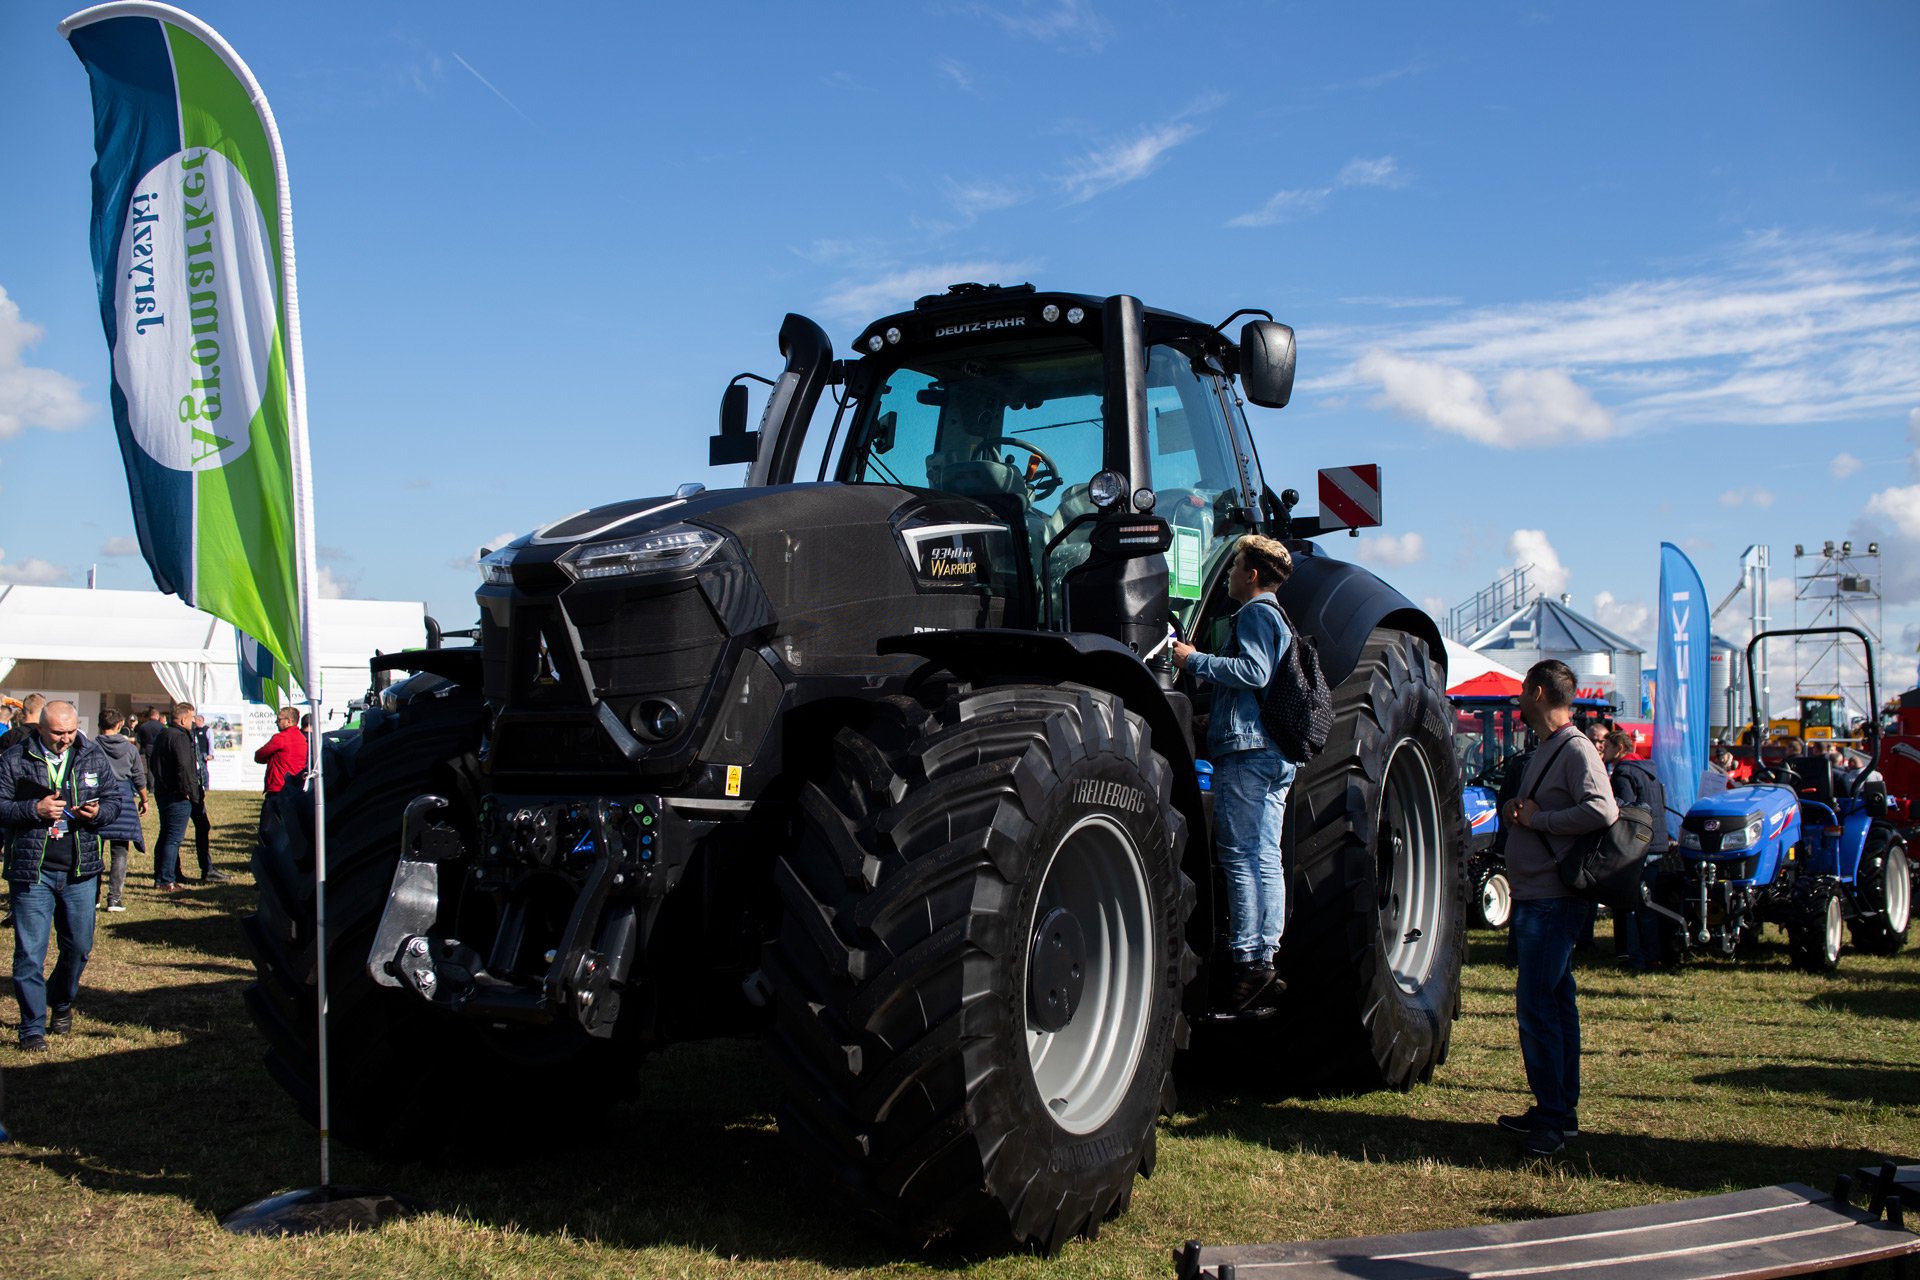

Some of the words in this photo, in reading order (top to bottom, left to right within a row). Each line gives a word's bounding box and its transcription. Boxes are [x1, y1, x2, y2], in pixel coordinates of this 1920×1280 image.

[935, 316, 1026, 338] DEUTZ-FAHR
[931, 547, 963, 560] 9340
[1574, 687, 1604, 699] NIA
[1072, 778, 1146, 814] TRELLEBORG
